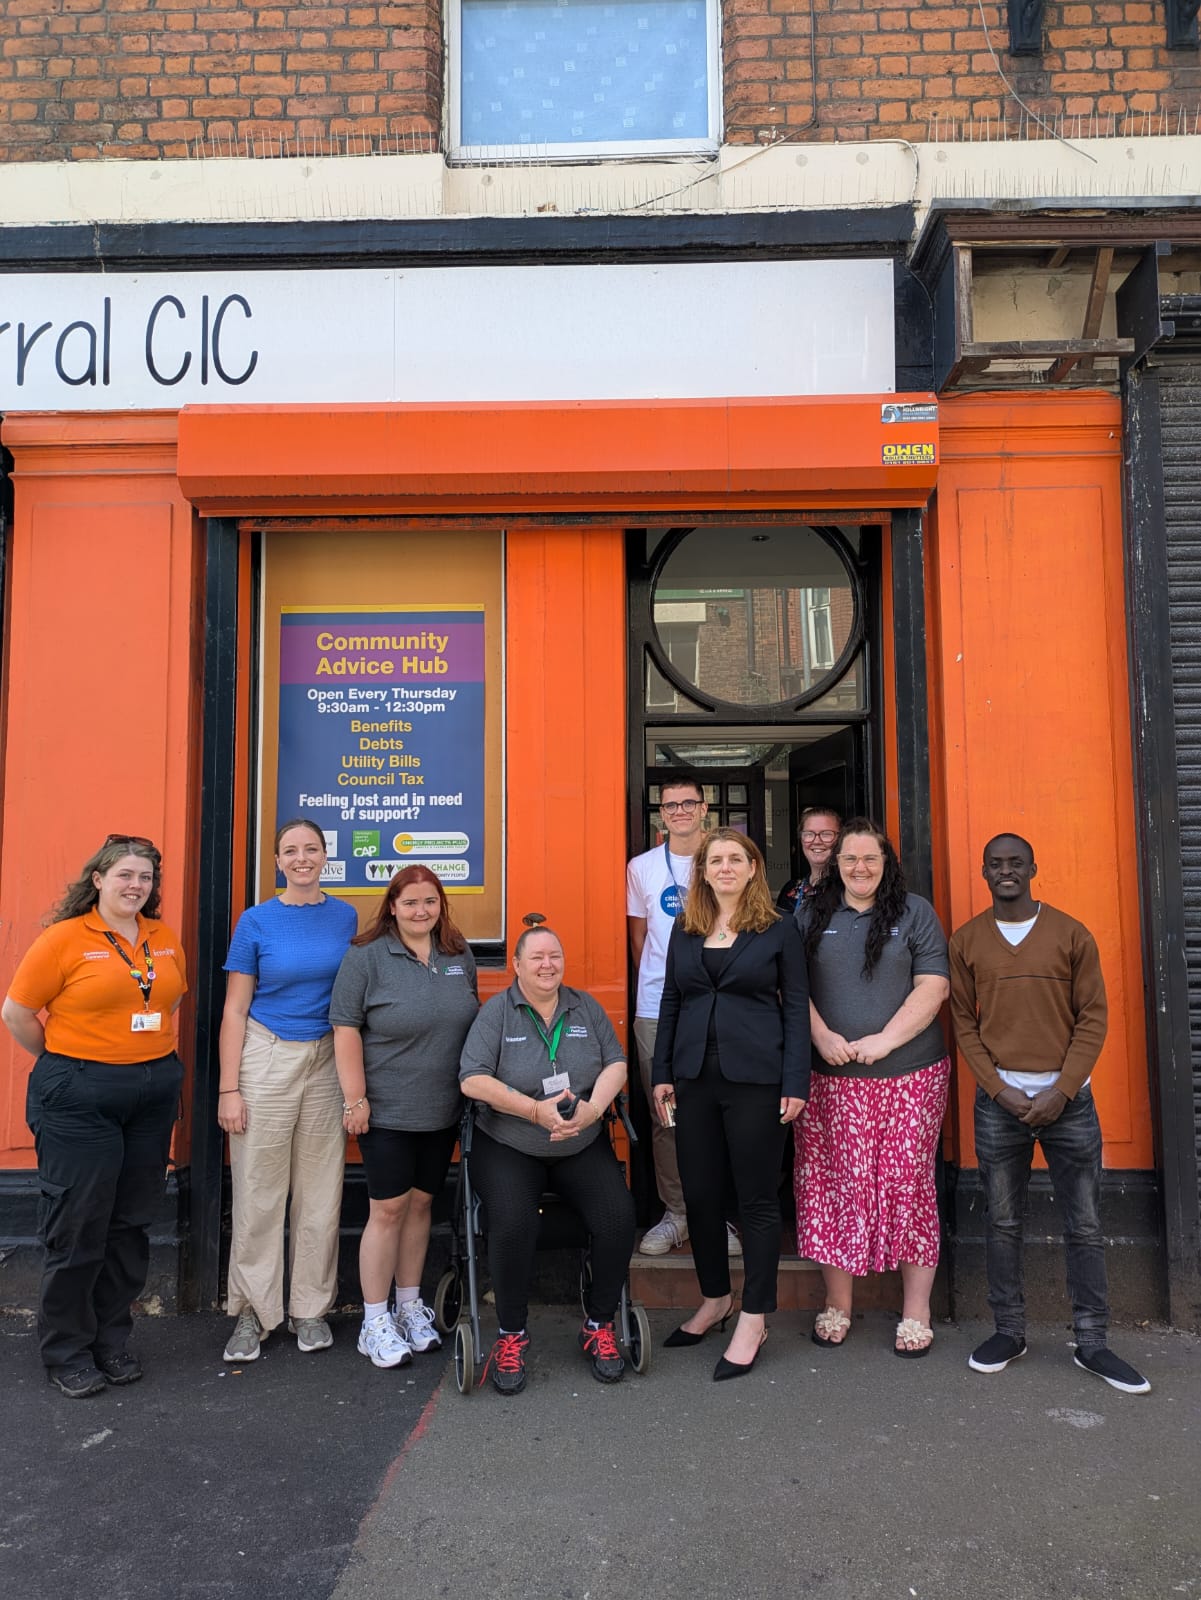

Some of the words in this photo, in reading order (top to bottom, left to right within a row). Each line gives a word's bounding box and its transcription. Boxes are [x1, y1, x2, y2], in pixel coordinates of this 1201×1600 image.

[145, 294, 259, 386] CIC
[883, 444, 933, 455] OWEN
[316, 631, 449, 653] Community
[315, 656, 394, 675] Advice
[402, 656, 448, 674] Hub
[307, 689, 344, 702] Open
[348, 688, 388, 701] Every
[391, 687, 457, 700] Thursday
[317, 702, 370, 713] 9:30am
[385, 701, 446, 714] 12:30pm
[351, 720, 412, 732] Benefits
[359, 738, 404, 750] Debts
[342, 755, 385, 770] Utility
[389, 755, 421, 768] Bills
[337, 773, 395, 786] Council
[399, 772, 425, 785] Tax
[299, 794, 348, 810] Feeling
[353, 794, 379, 807] lost
[382, 793, 408, 806] and
[412, 793, 426, 806] in
[429, 792, 463, 806] need
[341, 807, 355, 820] of
[358, 806, 420, 823] support?
[353, 845, 377, 857] CAP
[321, 863, 343, 875] olve
